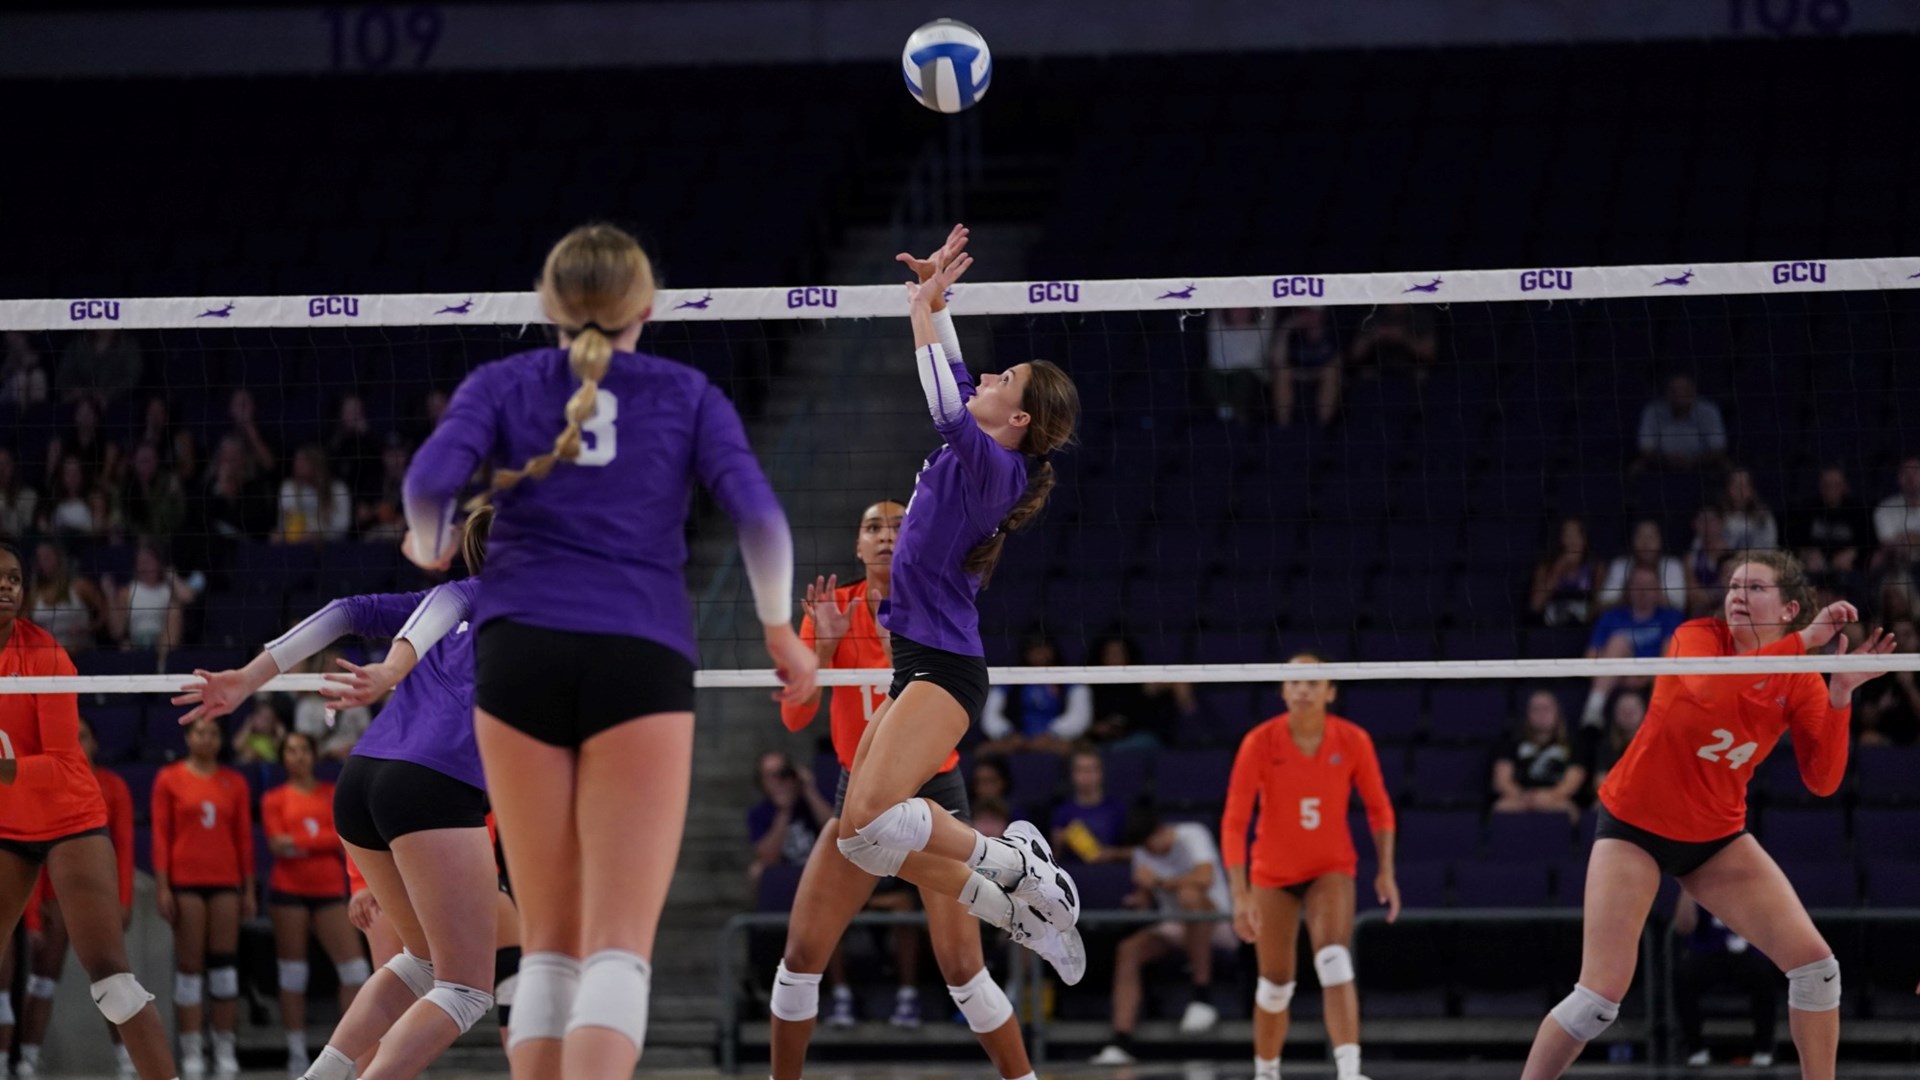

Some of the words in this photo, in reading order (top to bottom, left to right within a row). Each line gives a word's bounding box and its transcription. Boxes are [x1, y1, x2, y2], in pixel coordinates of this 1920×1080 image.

[322, 5, 446, 70] 109
[1520, 269, 1572, 291] GCU
[1773, 262, 1827, 285] GCU
[787, 286, 837, 309] GCU
[1029, 281, 1079, 304] GCU
[1273, 276, 1323, 299] GCU
[70, 300, 120, 321] GCU
[309, 296, 359, 318] GCU
[575, 388, 618, 467] 3
[1696, 728, 1759, 770] 24
[1299, 797, 1321, 831] 5
